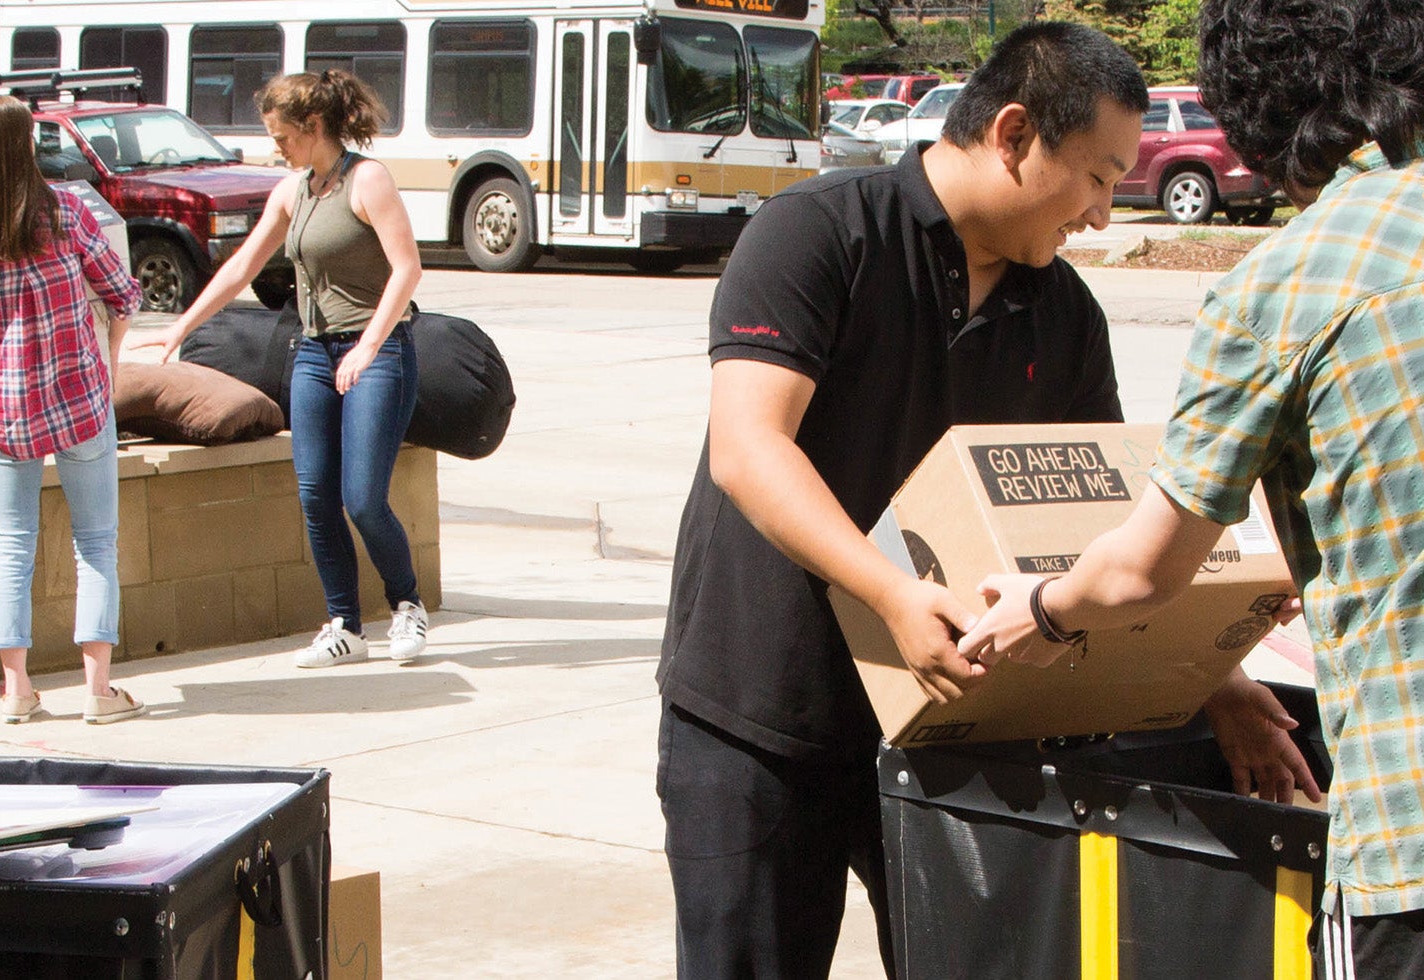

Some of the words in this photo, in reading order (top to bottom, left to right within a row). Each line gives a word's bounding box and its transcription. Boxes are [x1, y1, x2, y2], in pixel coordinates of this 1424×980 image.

[988, 448, 1022, 474] GO
[1025, 447, 1105, 473] AHEAD,
[997, 474, 1083, 501] REVIEW
[1083, 473, 1125, 498] ME.
[1030, 556, 1065, 572] TAKE
[1205, 549, 1241, 563] wegg
